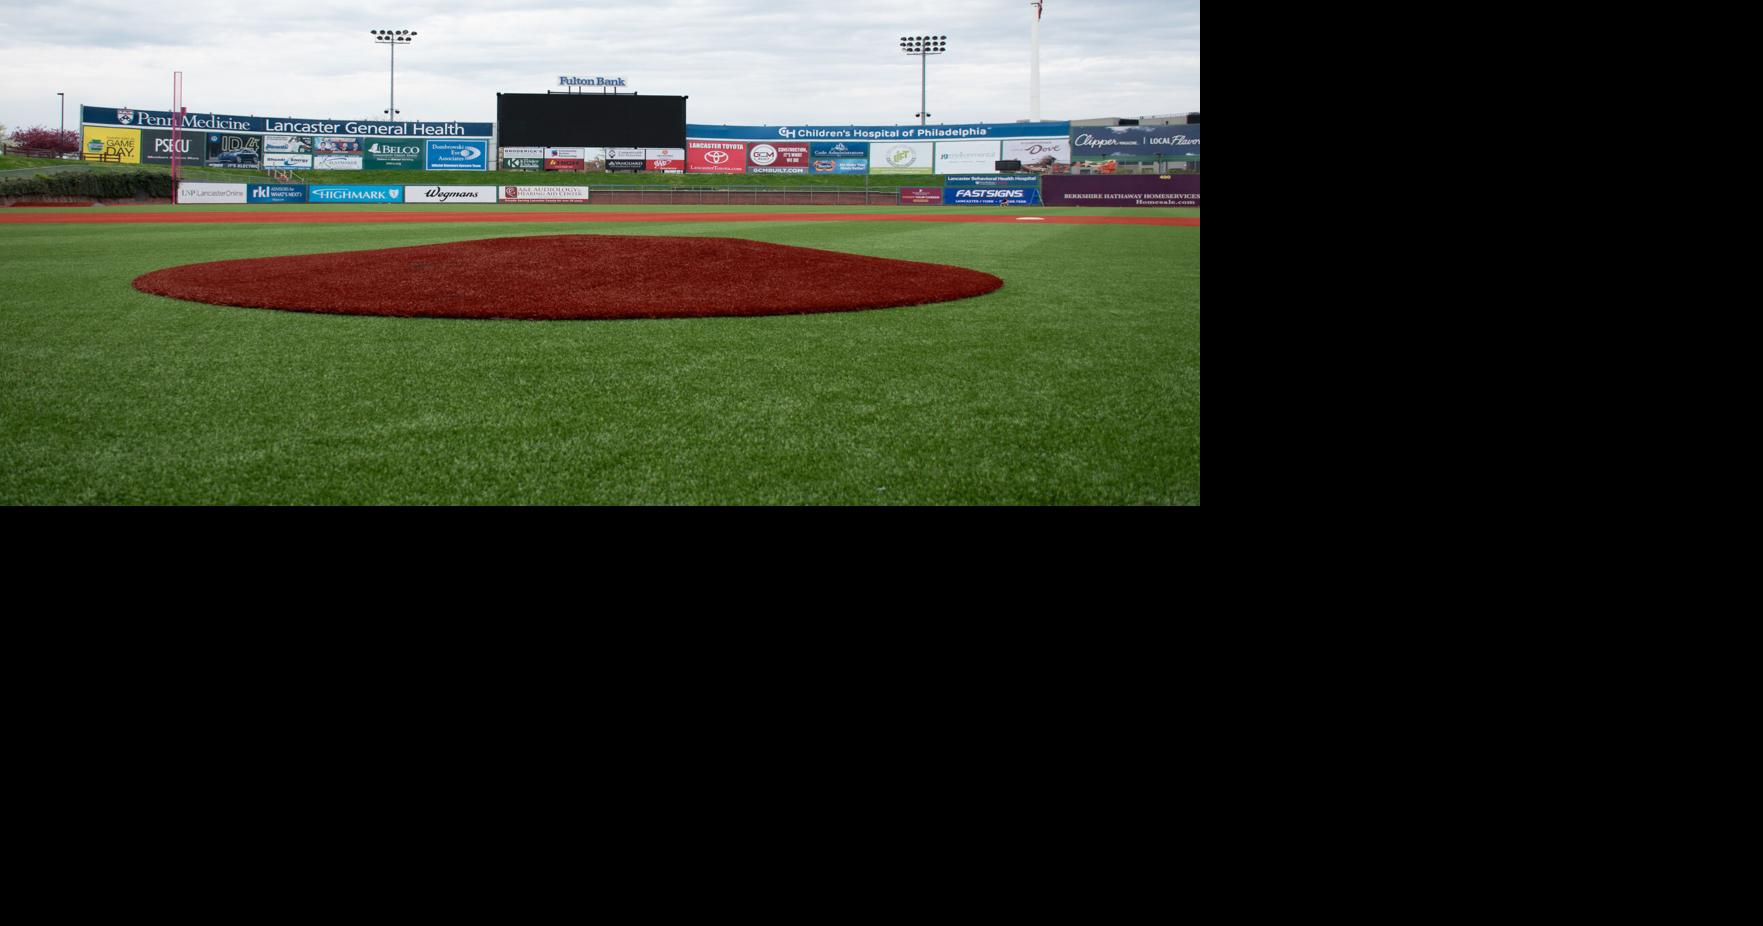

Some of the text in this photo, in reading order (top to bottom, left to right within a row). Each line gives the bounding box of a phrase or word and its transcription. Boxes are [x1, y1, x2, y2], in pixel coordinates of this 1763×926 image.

[559, 76, 626, 87] Fulton Bank
[137, 111, 251, 131] Penn Medicine
[265, 119, 465, 136] Lancaster General Health
[797, 129, 851, 138] Children's
[853, 128, 899, 139] Hospital
[902, 129, 914, 138] of
[917, 127, 987, 138] Philadelphia
[106, 140, 135, 148] GAME
[155, 138, 190, 153] PSECU
[1074, 133, 1119, 148] Clipper
[1149, 137, 1171, 145] LOCAL
[382, 145, 420, 154] BELCO
[1025, 144, 1061, 155] Dove
[197, 189, 244, 197] LancasterOnline
[252, 186, 270, 198] rkl
[320, 190, 386, 199] HIGHMARK
[424, 186, 479, 202] Wegmans
[955, 189, 1023, 198] FASTSIGNS
